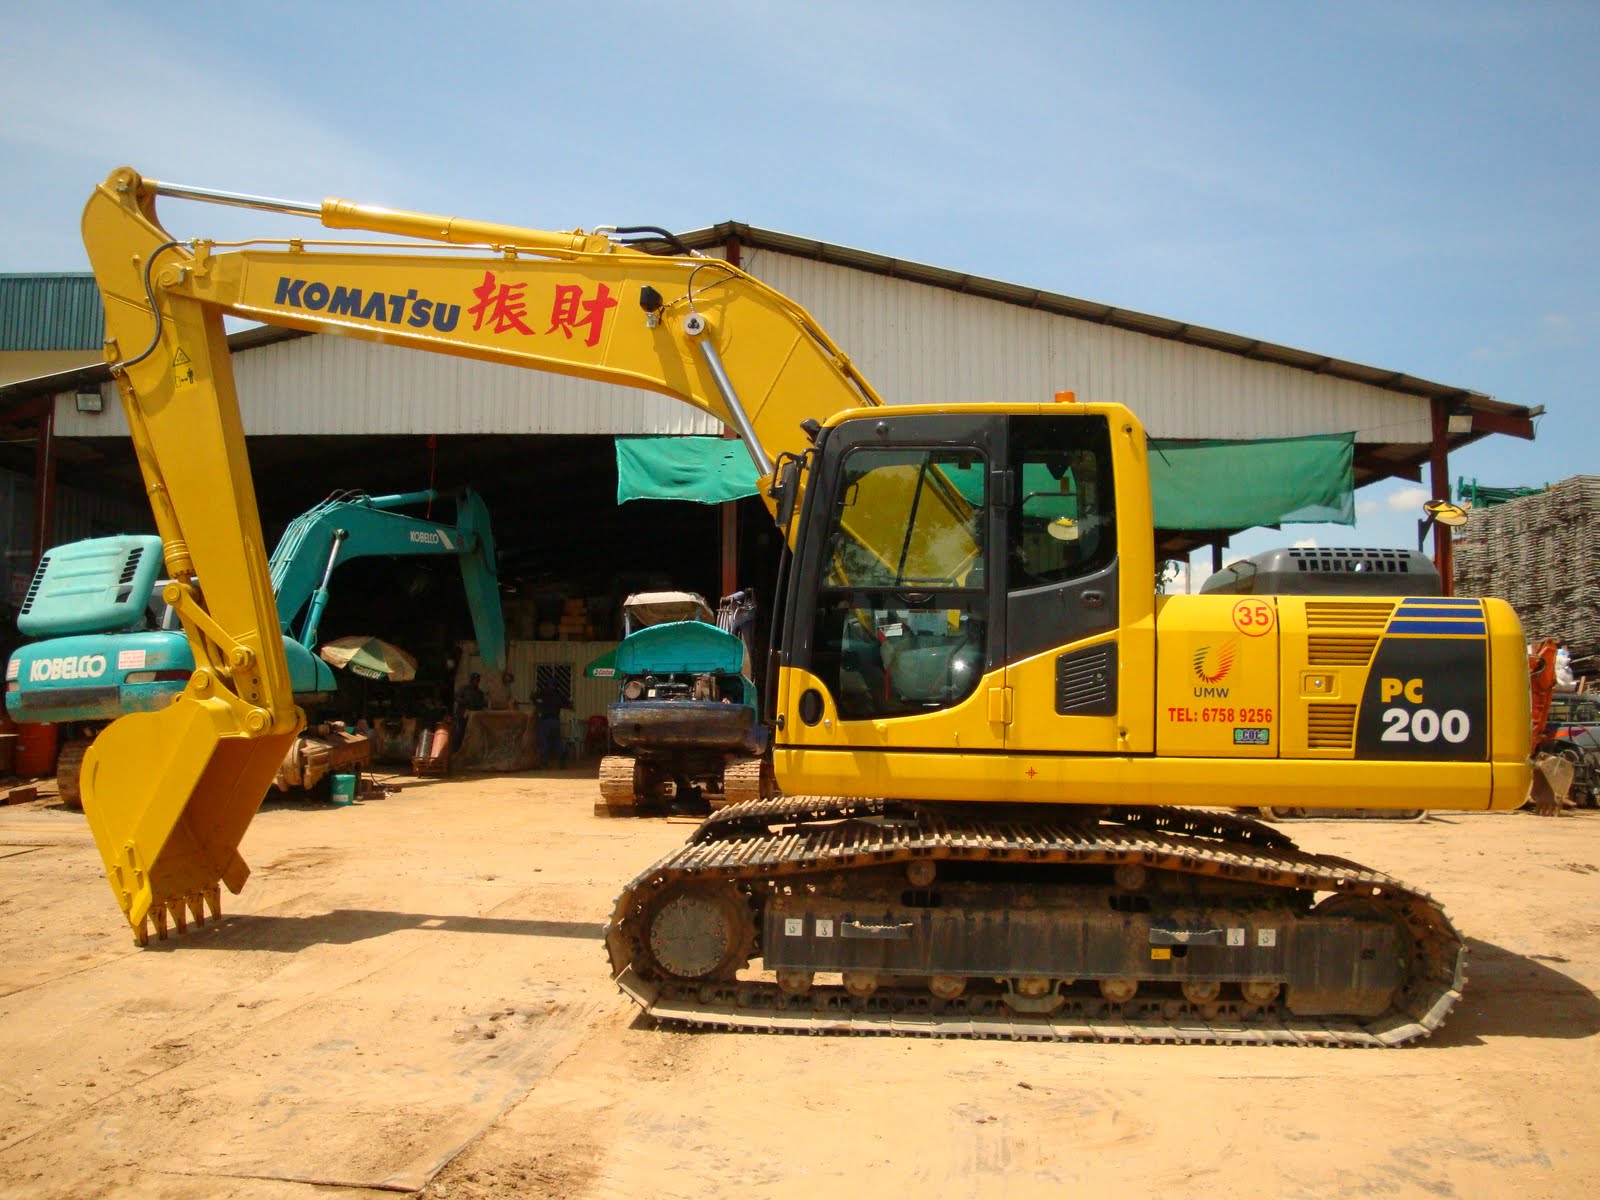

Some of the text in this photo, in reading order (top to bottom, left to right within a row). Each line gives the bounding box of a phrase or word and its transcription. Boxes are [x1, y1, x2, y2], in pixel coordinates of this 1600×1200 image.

[274, 276, 461, 333] KOMATSU
[467, 271, 618, 348] 振財
[410, 531, 439, 544] KOBELCO
[1238, 606, 1269, 626] 35
[30, 654, 107, 682] KOBELCO
[352, 664, 382, 679] Castrol
[1193, 687, 1229, 698] UMW
[1381, 678, 1423, 704] PC
[1168, 708, 1273, 723] TEL: 6758 9256
[1381, 708, 1470, 743] 200
